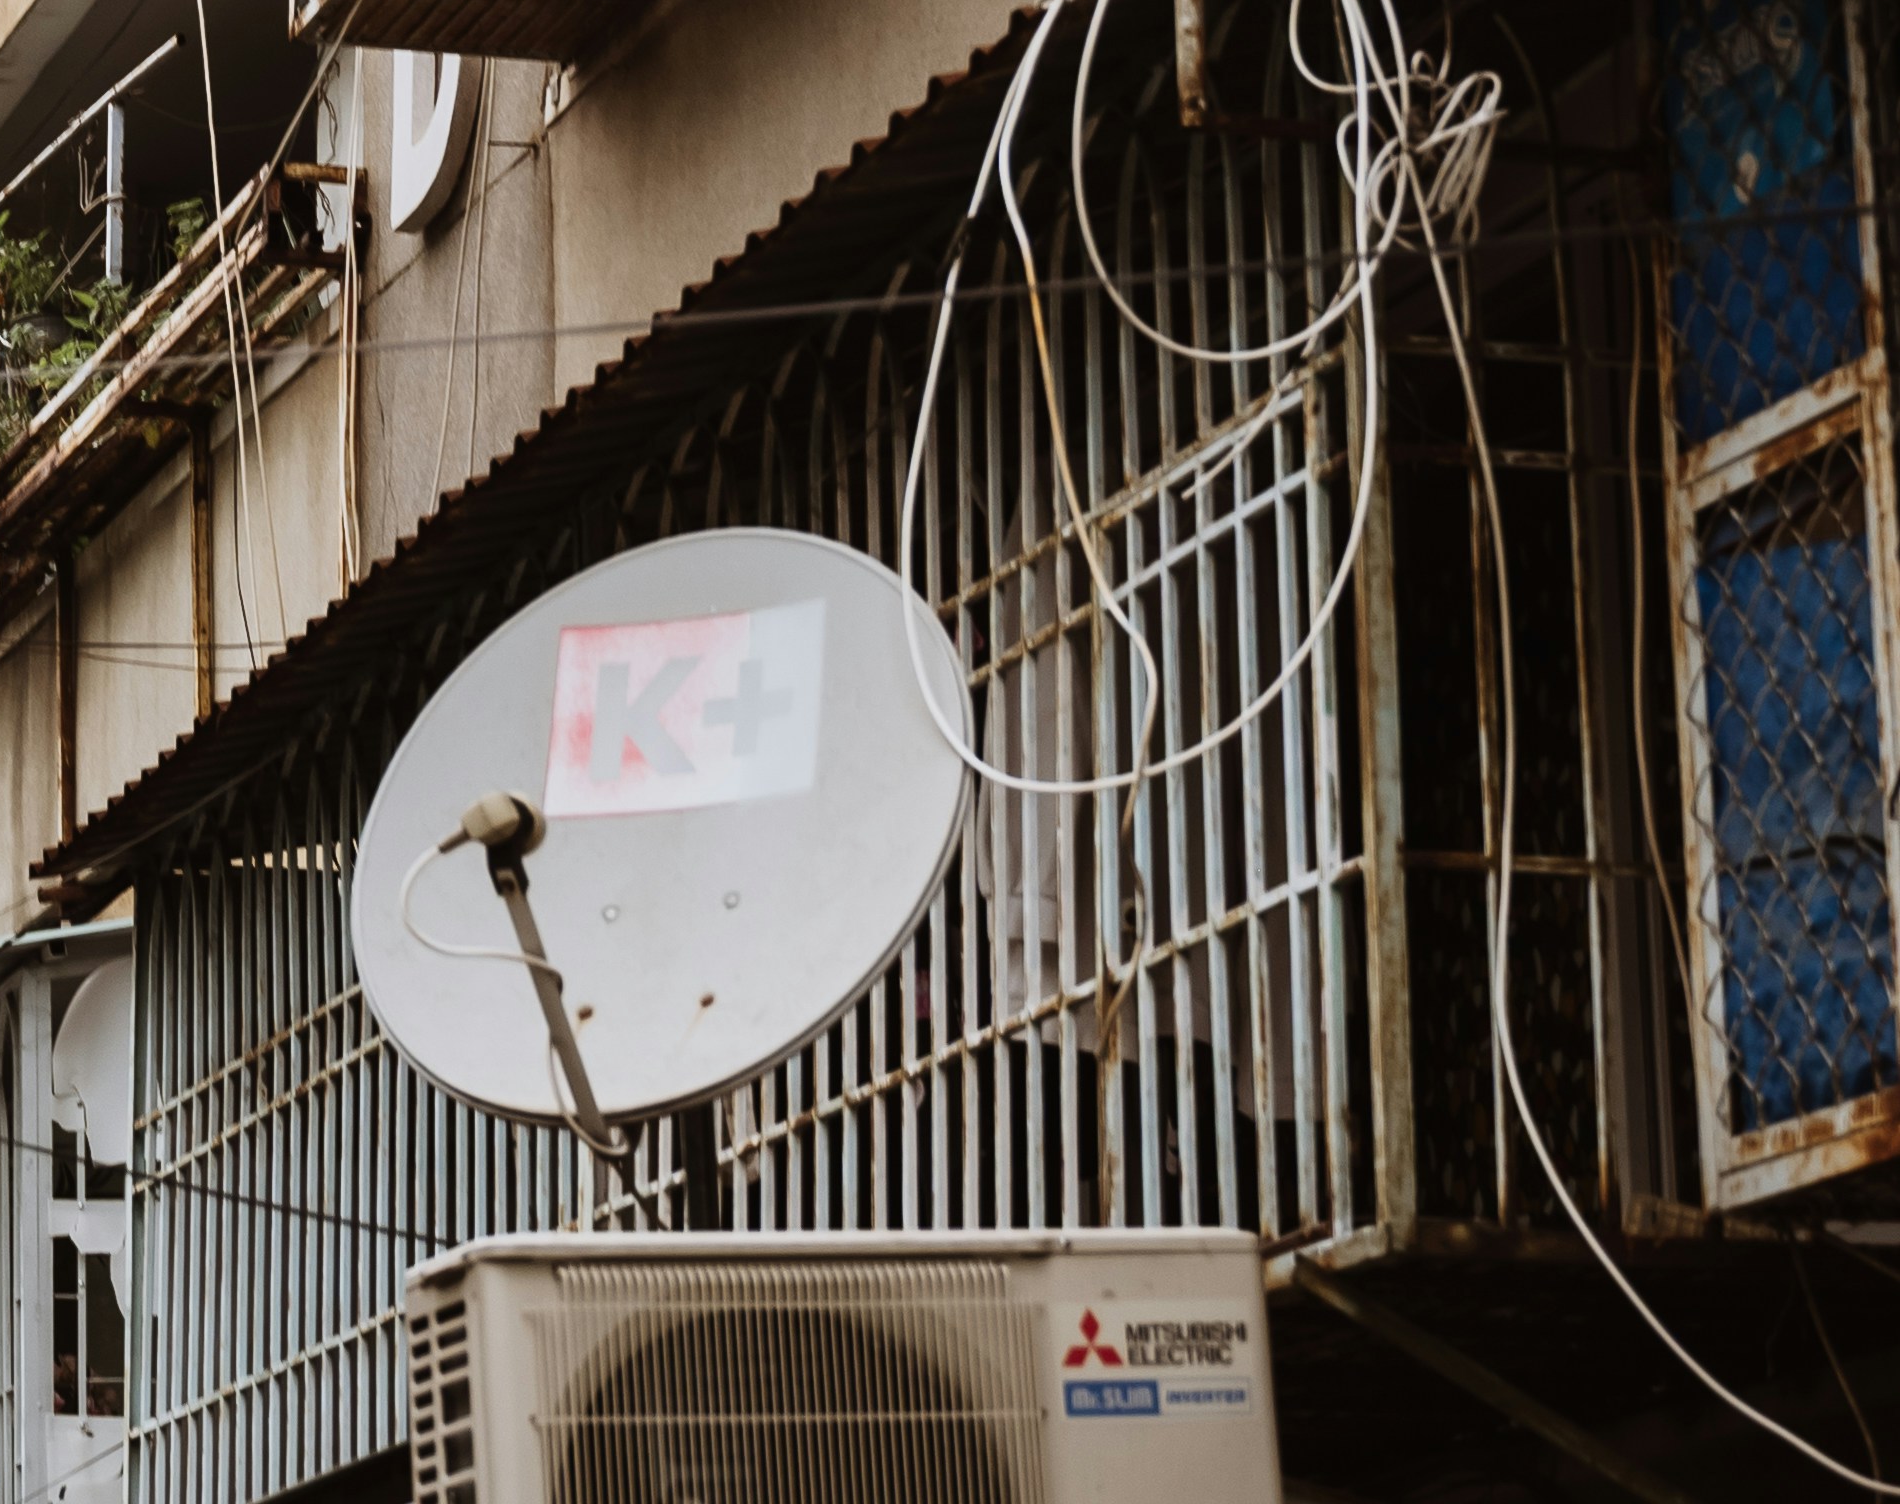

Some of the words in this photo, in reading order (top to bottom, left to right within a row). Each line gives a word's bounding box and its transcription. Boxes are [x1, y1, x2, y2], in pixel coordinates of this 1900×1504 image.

[588, 655, 796, 782] K+
[1125, 1321, 1248, 1343] MITSUBISHI
[1127, 1343, 1233, 1367] ELECTRIC
[1167, 1389, 1246, 1404] INVERTER
